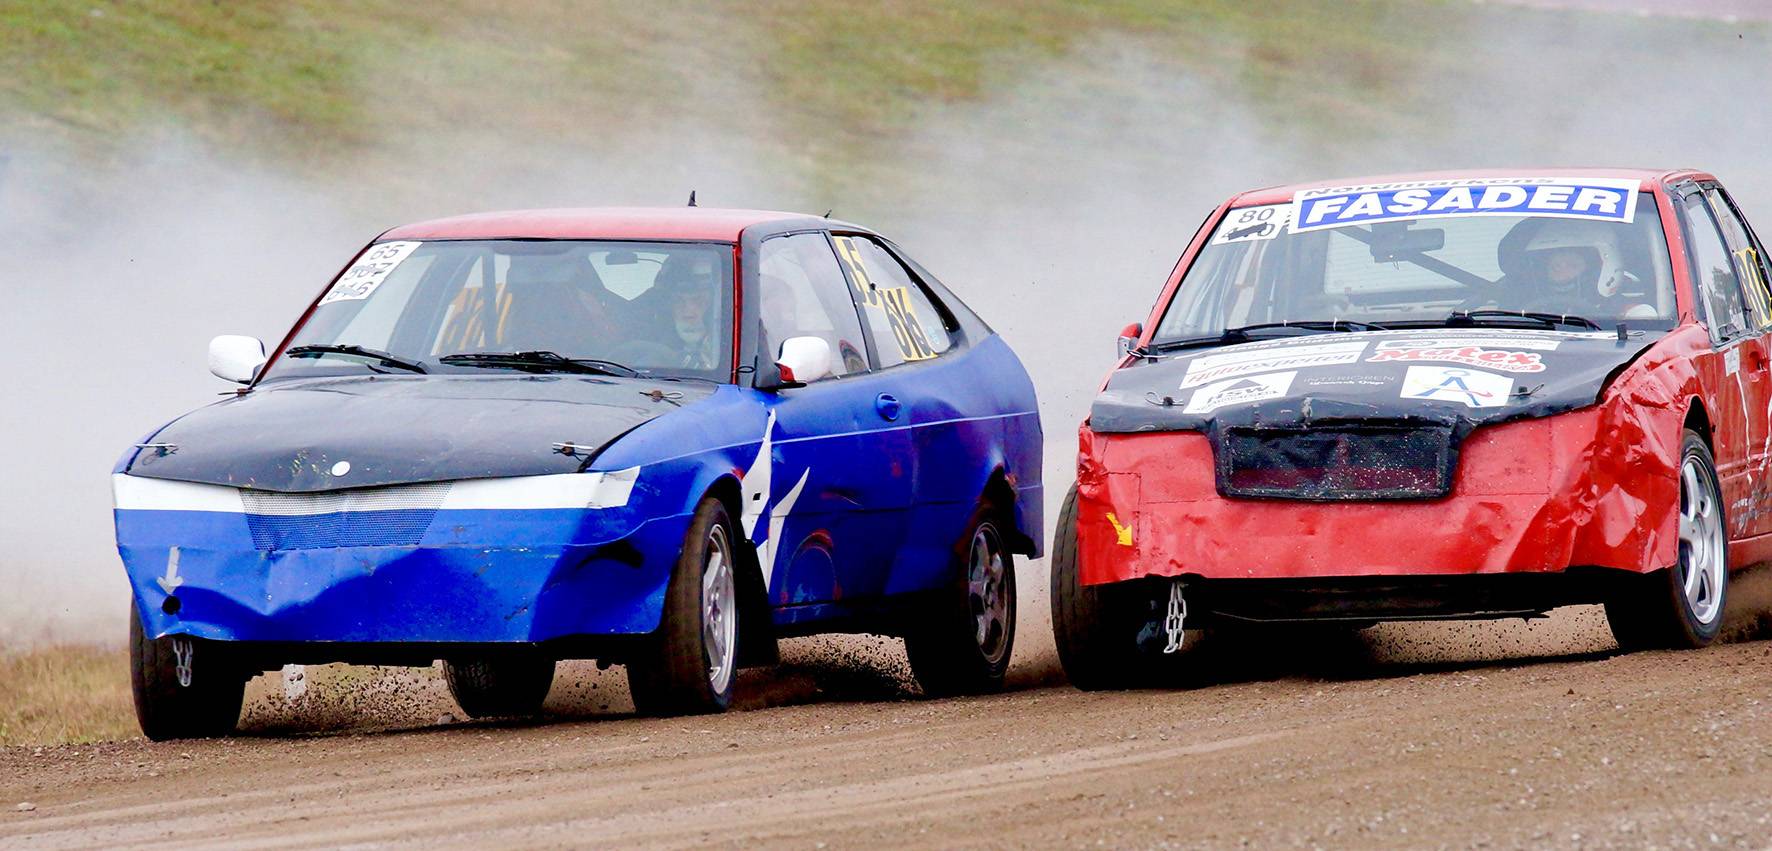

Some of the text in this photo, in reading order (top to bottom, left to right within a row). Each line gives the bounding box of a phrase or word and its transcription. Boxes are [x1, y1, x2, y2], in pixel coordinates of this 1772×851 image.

[1305, 185, 1622, 224] FASADER
[1238, 208, 1276, 223] 80
[370, 244, 405, 260] 65
[880, 287, 931, 359] 616
[1371, 347, 1541, 367] Motex
[1187, 352, 1356, 384] Autoexperten
[1206, 383, 1271, 404] HSW
